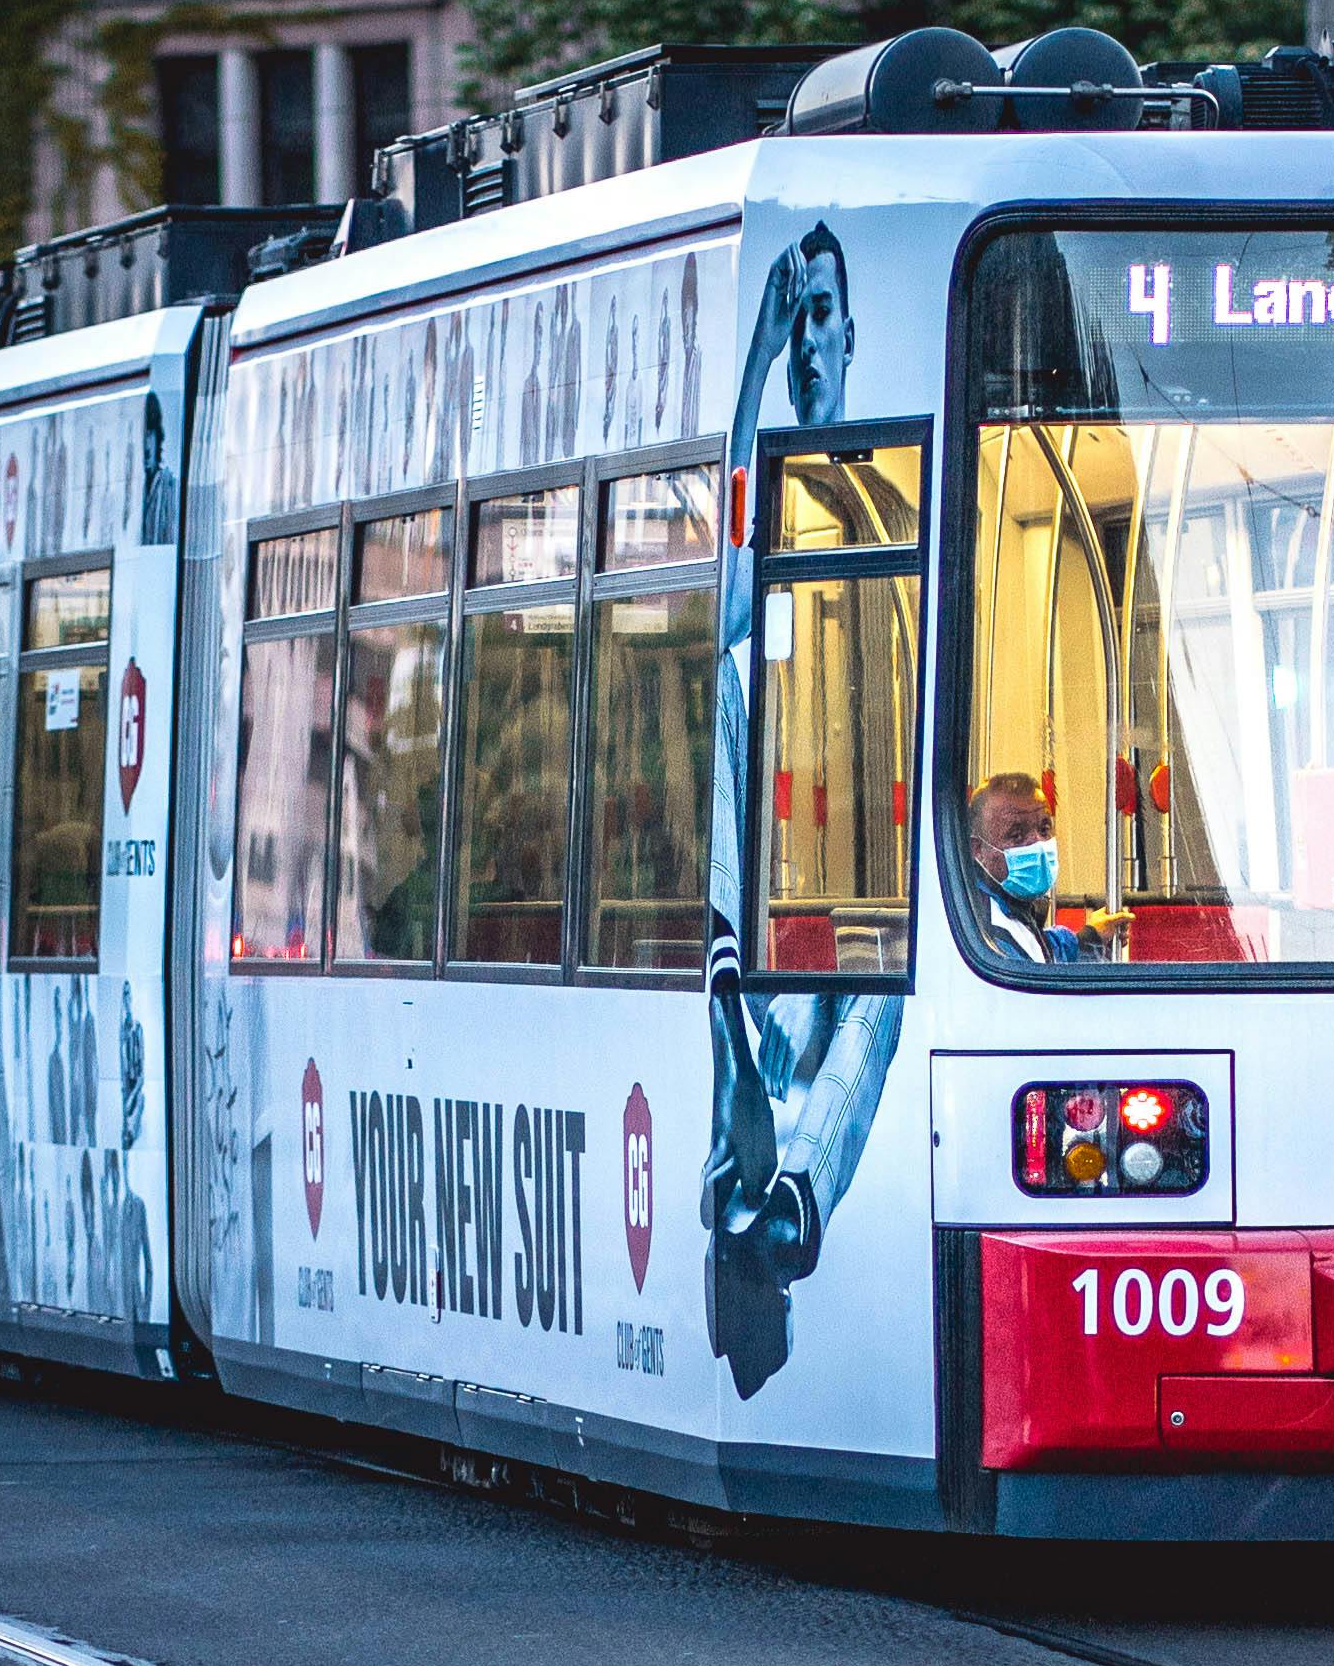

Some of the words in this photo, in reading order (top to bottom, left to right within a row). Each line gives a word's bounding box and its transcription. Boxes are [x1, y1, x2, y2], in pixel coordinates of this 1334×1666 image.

[1129, 263, 1170, 345] 4
[349, 1089, 429, 1307] YOUR
[433, 1097, 504, 1321] NEW
[513, 1102, 586, 1336] SUIT
[627, 1132, 649, 1229] CG
[1071, 1267, 1246, 1337] 1009
